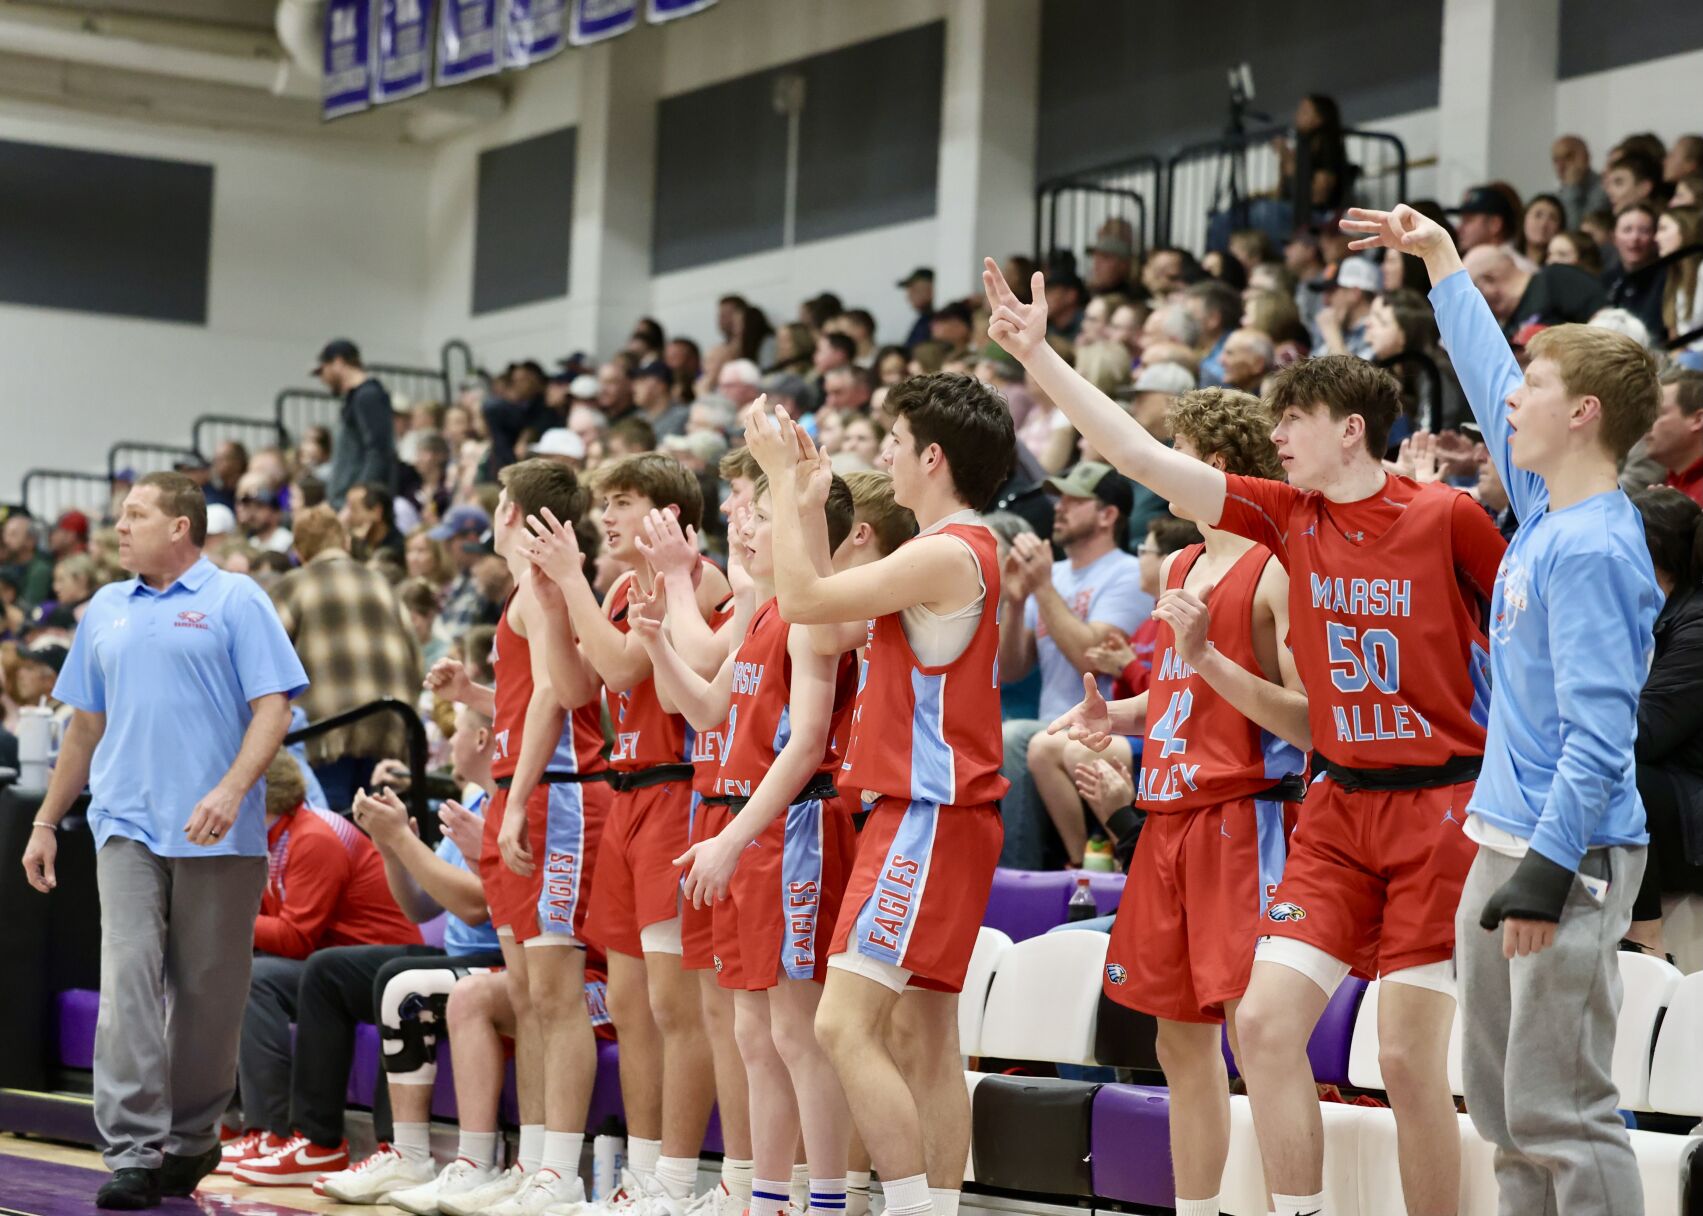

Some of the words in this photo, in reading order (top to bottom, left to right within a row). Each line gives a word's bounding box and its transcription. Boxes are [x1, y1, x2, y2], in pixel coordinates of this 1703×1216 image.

[1310, 572, 1411, 617] MARSH
[1326, 620, 1400, 694] 50
[1149, 687, 1193, 758] 42
[1331, 703, 1432, 742] ALLEY
[1136, 763, 1200, 801] ALLEY
[549, 851, 574, 924] EAGLES
[868, 854, 919, 951] EAGLES
